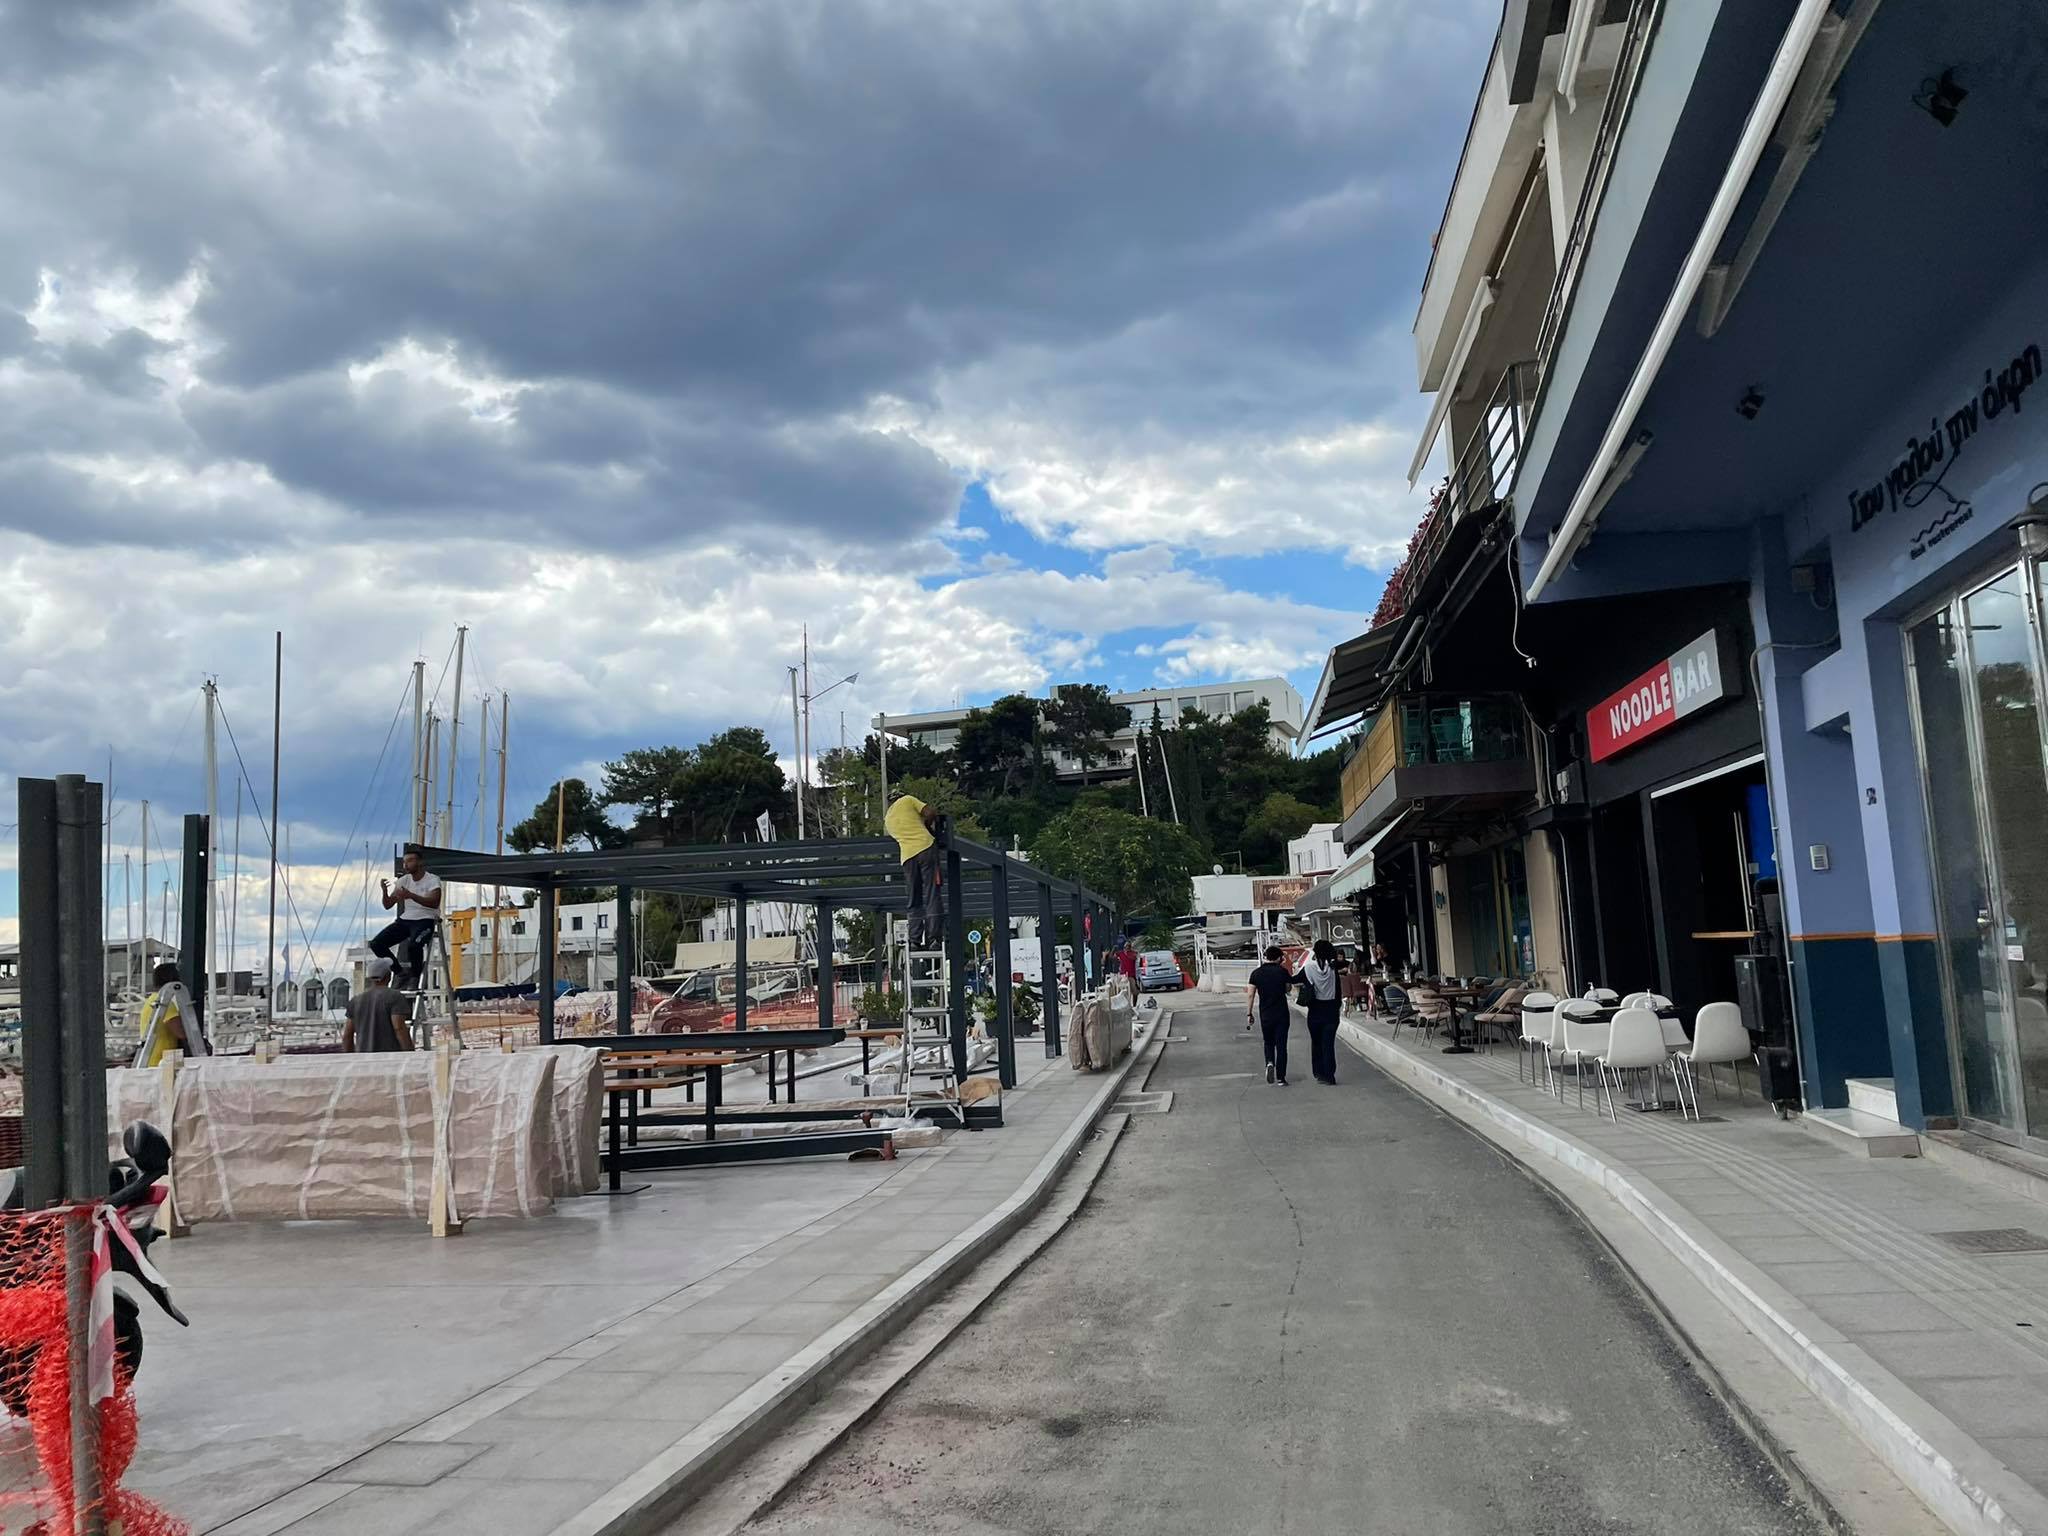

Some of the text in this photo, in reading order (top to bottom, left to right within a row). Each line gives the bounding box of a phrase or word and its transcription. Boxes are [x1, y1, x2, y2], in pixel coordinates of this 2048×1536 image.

[1982, 343, 2042, 420] άκρη
[1609, 651, 1712, 739] NOODLE BAR
